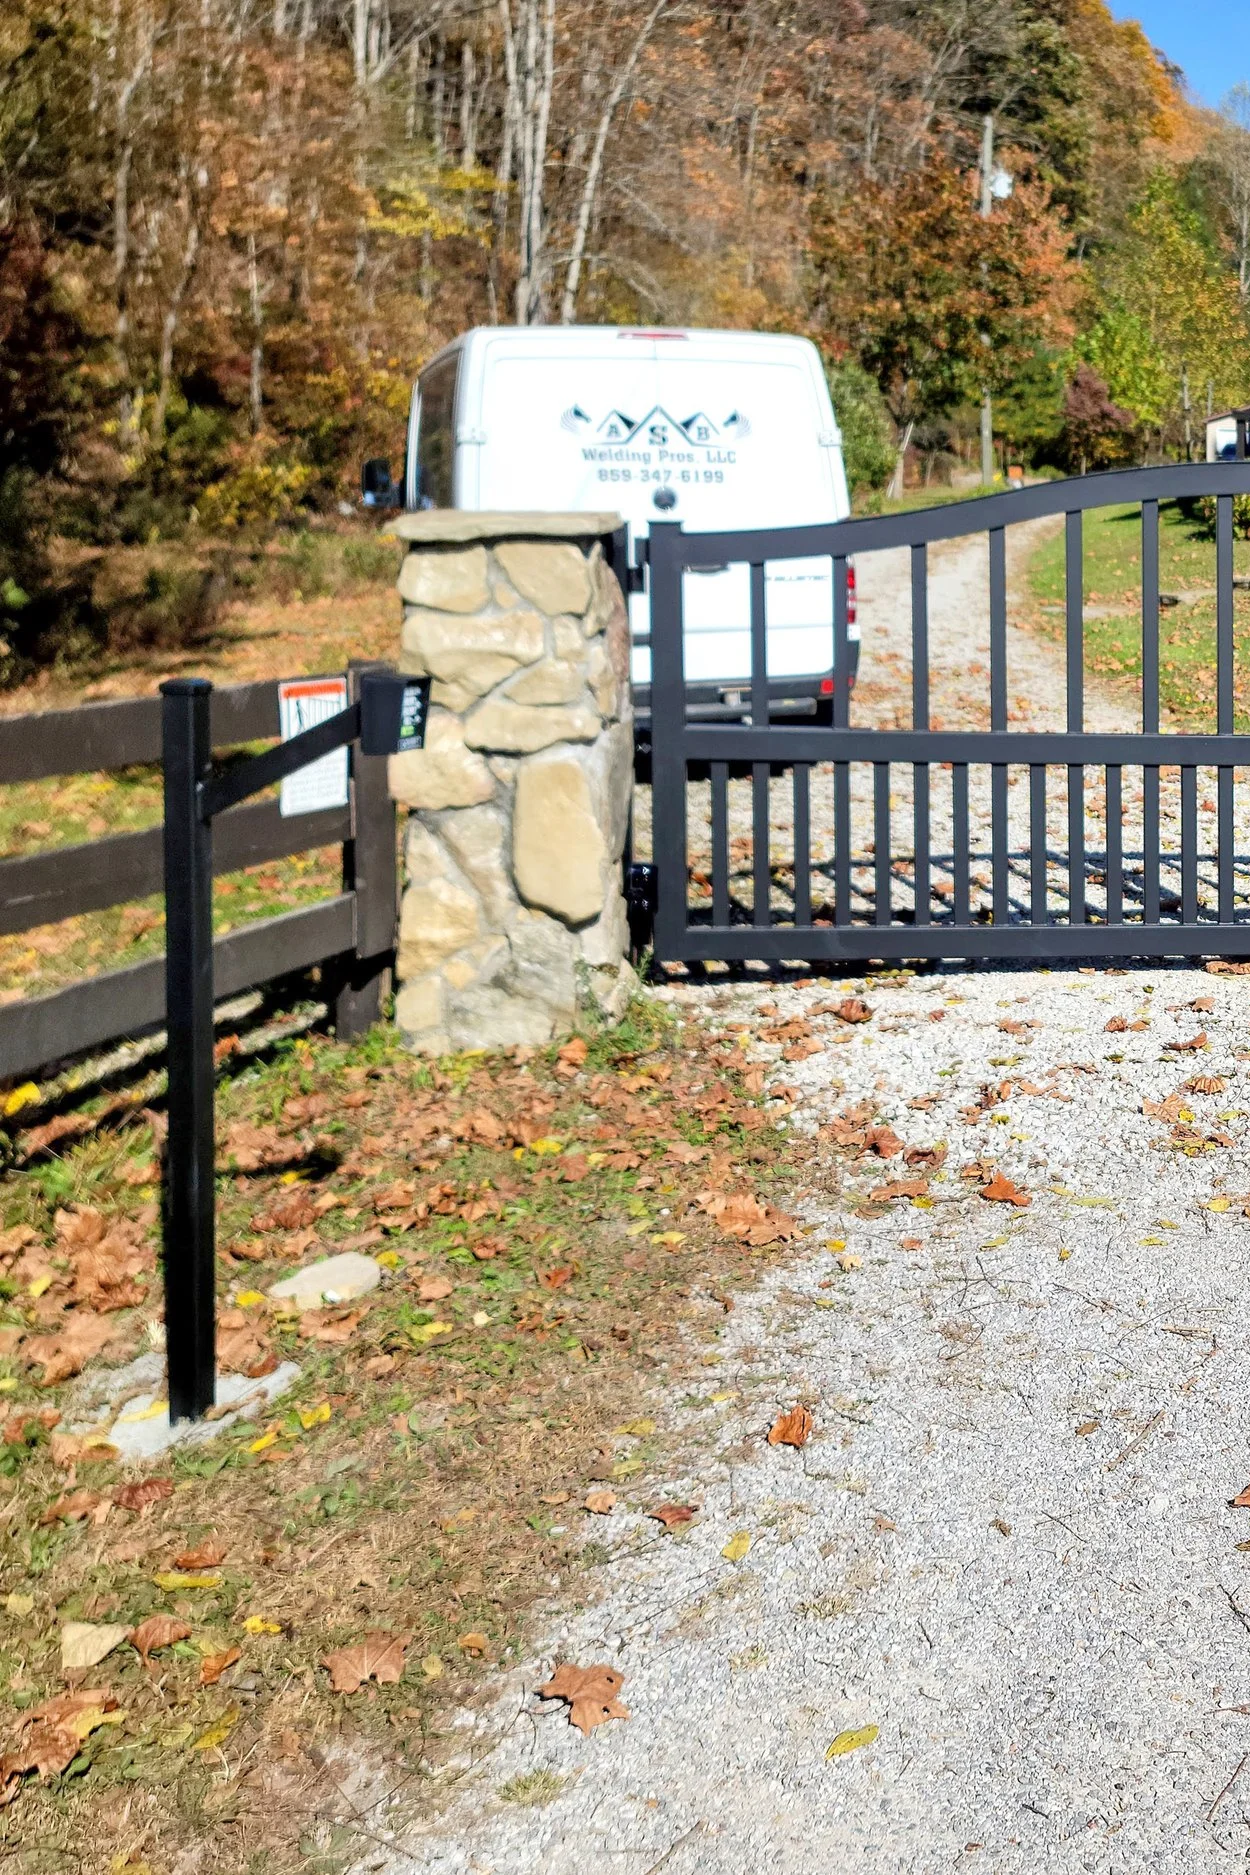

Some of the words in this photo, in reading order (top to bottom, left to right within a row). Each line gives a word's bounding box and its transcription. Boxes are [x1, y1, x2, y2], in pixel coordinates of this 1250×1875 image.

[606, 423, 621, 438] A
[648, 425, 669, 446] S
[696, 426, 710, 441] B
[581, 448, 651, 464] Welding
[706, 451, 736, 464] LLC
[597, 468, 724, 483] 859-347-6199
